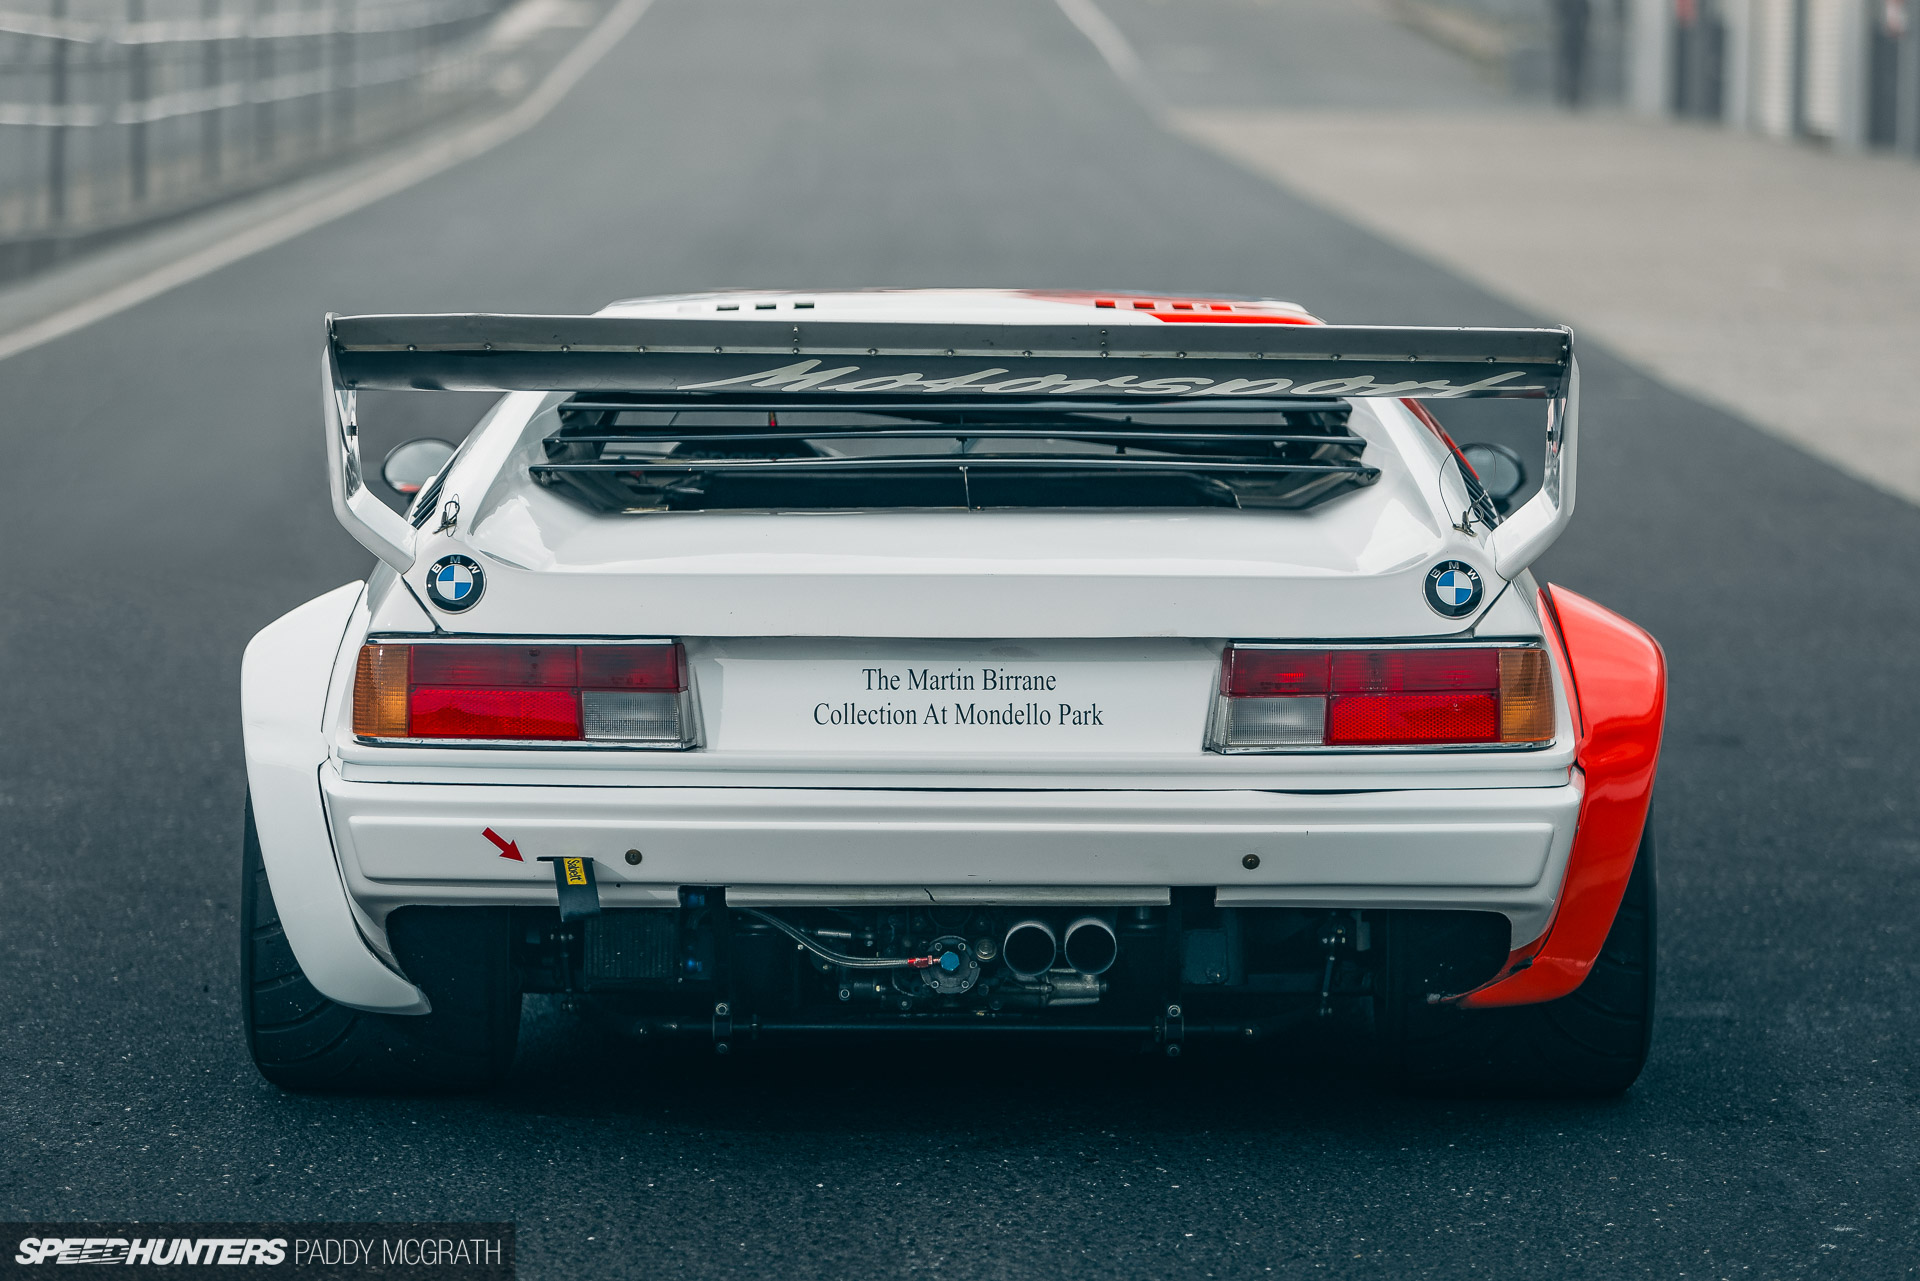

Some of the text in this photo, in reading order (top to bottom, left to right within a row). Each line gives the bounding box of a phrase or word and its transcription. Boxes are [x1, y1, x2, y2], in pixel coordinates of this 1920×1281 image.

[676, 358, 1546, 398] Motorsport
[431, 555, 481, 575] BMW
[1429, 561, 1479, 581] BMW
[861, 668, 1057, 691] The Martin Birrane
[813, 702, 1105, 726] Collection At Mondello Park
[567, 859, 583, 882] Sabelt
